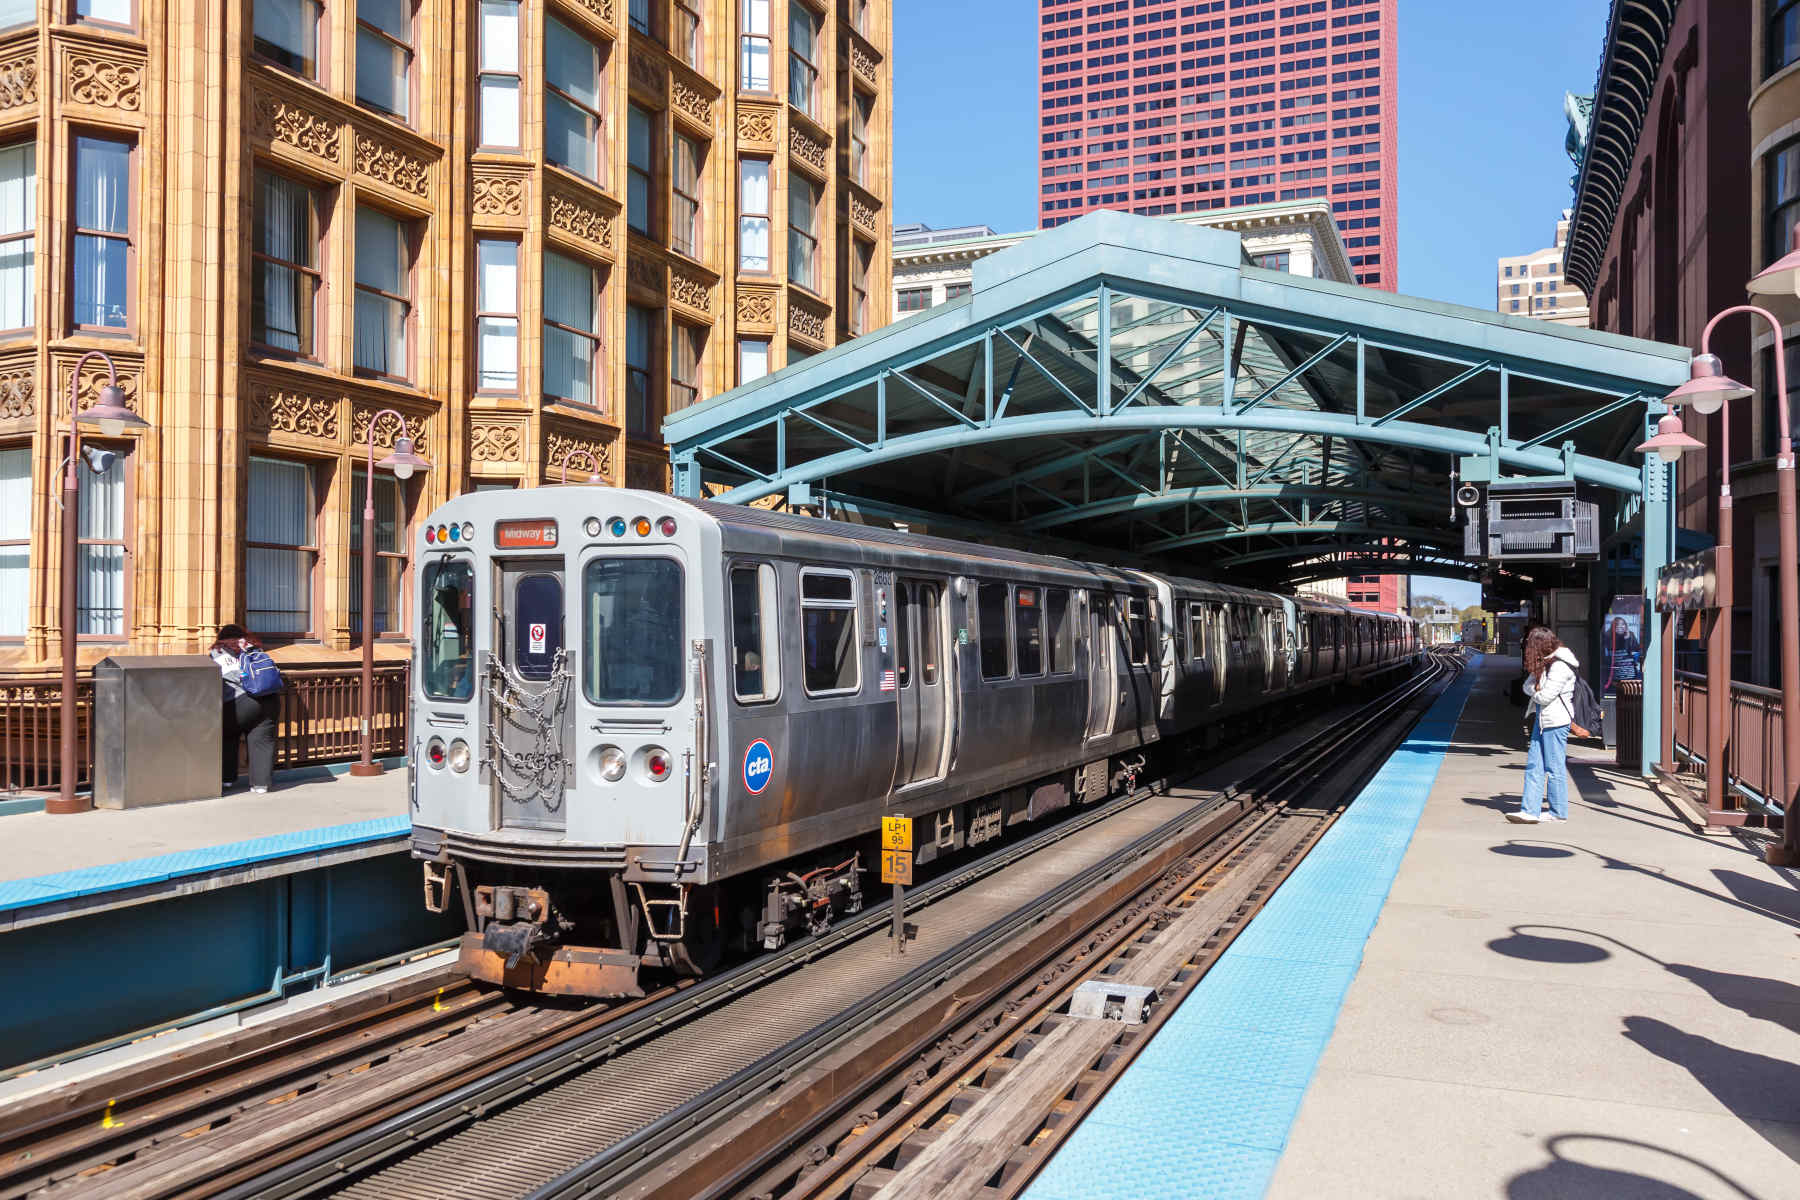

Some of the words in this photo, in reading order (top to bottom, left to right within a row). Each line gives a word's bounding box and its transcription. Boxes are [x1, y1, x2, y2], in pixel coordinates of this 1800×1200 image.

[505, 528, 541, 541] Midway
[748, 757, 769, 776] cta
[888, 823, 906, 832] LP1
[891, 835, 904, 845] 95
[885, 855, 906, 873] 15
